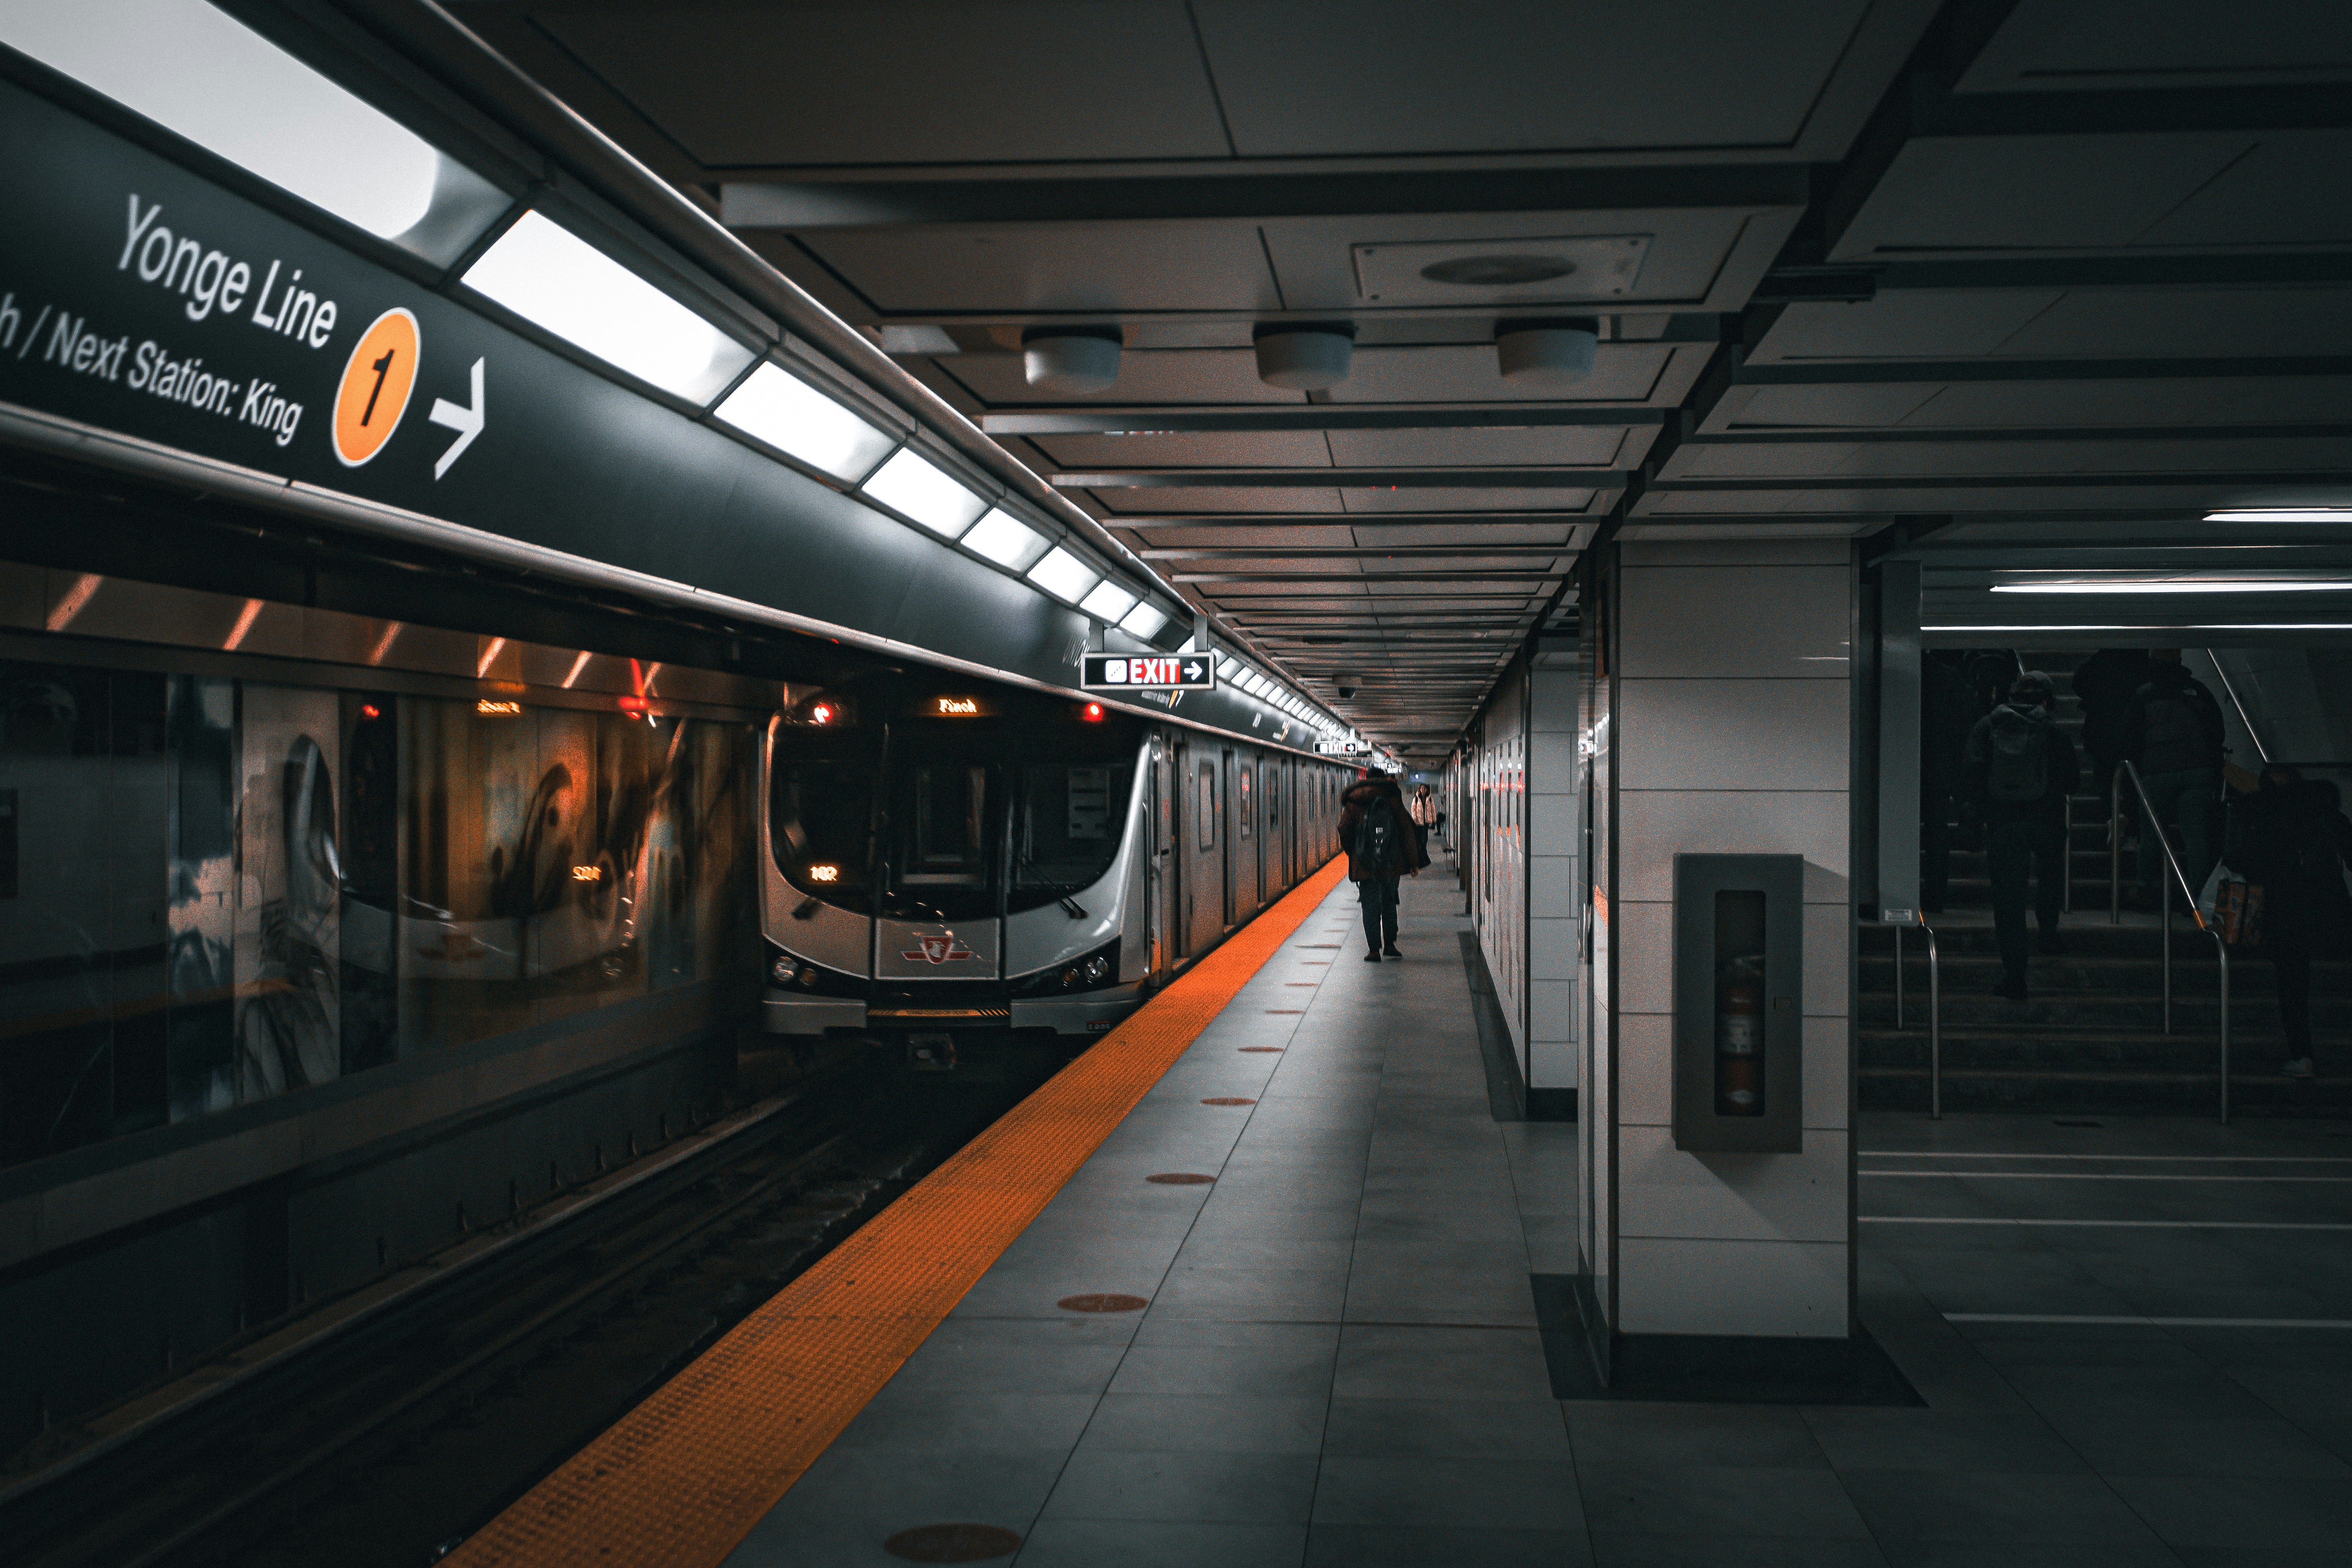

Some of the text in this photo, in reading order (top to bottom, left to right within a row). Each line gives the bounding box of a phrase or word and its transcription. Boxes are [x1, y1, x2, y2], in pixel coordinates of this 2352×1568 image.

[118, 192, 338, 350] Yonge Line
[45, 311, 128, 381] Next
[127, 339, 240, 416] Station:
[238, 377, 304, 448] King
[361, 349, 394, 427] 1
[939, 699, 977, 713] Finch
[1130, 658, 1179, 684] EXIT
